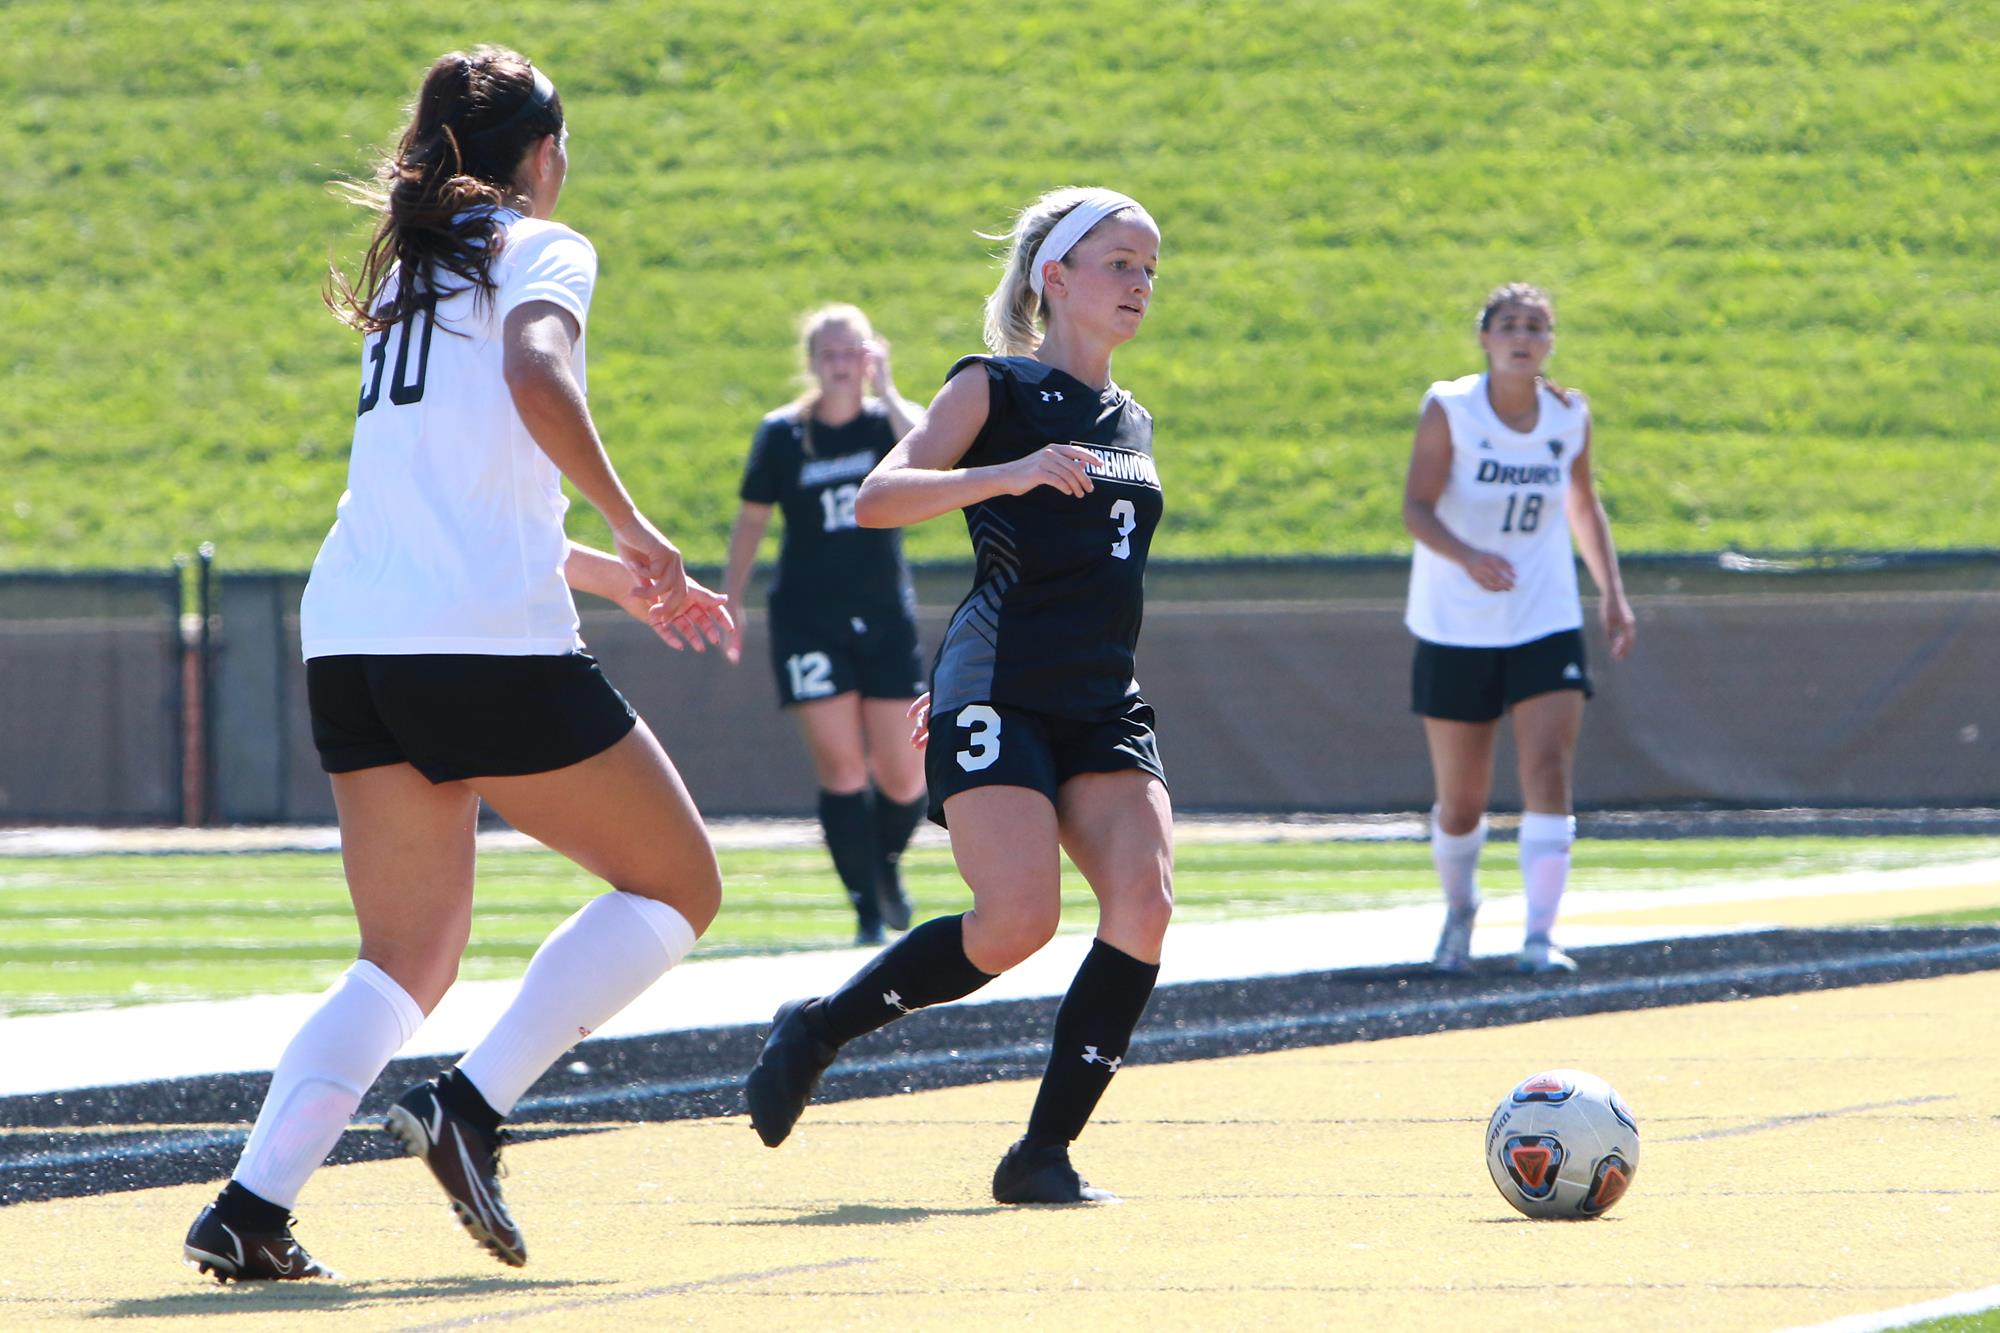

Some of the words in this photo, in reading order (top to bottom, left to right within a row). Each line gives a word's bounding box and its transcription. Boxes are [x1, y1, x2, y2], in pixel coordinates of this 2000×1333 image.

[357, 293, 437, 418] 30
[820, 484, 859, 532] 12
[1110, 499, 1136, 559] 3
[1502, 493, 1543, 533] 18
[785, 651, 837, 700] 12
[956, 704, 1001, 772] 3
